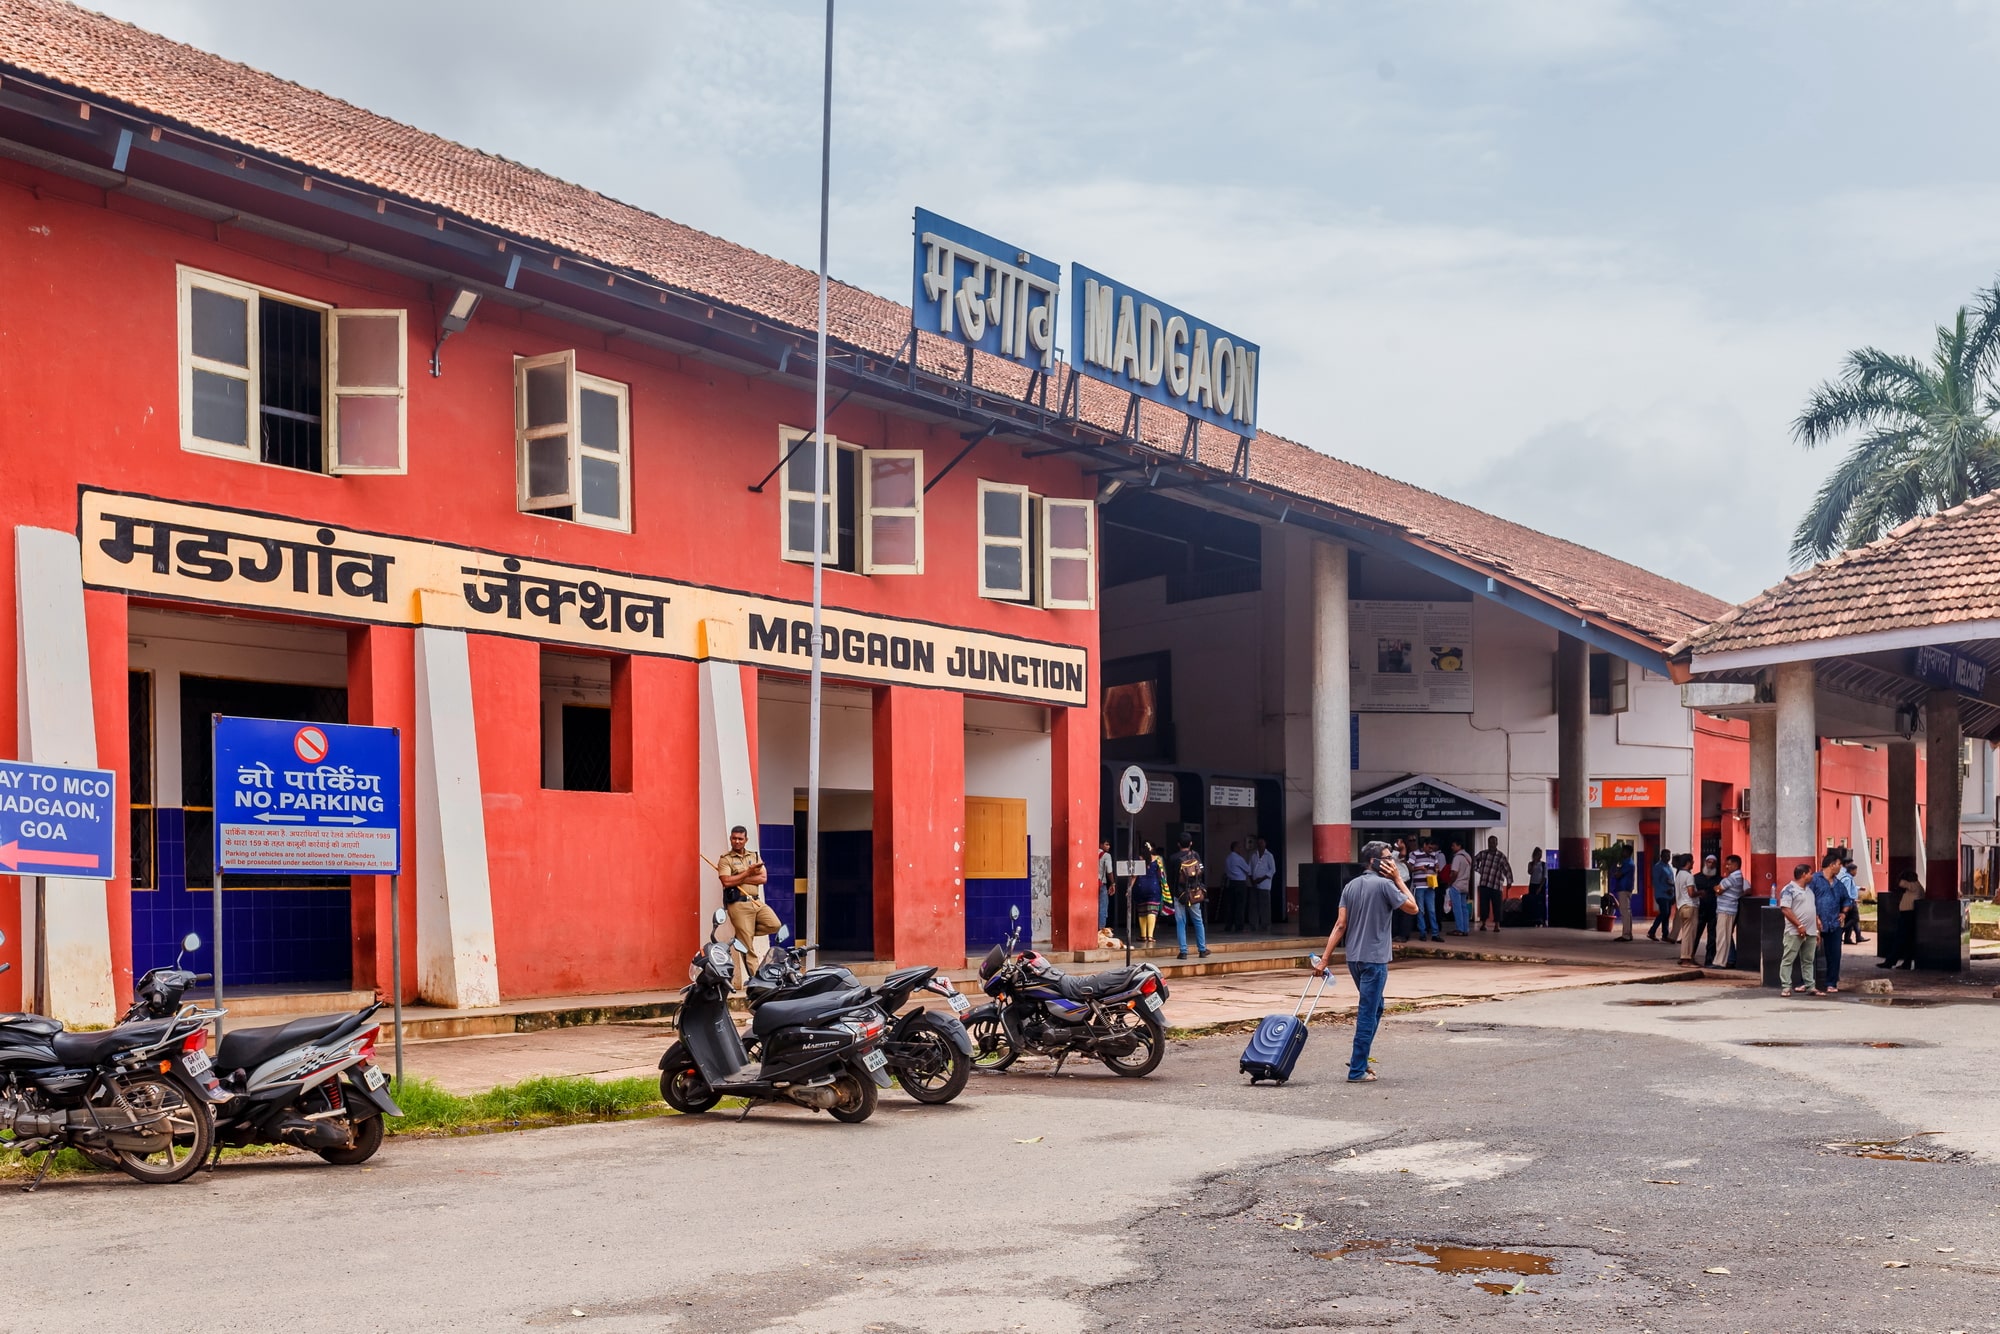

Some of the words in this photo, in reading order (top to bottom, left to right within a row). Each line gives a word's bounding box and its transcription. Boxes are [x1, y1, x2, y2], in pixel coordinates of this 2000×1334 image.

[1084, 278, 1256, 424] MADGAON
[99, 512, 396, 603] मडगांव
[461, 557, 670, 639] जंक्शन
[749, 613, 934, 673] MADGAON
[947, 646, 1082, 692] JUNCTION
[29, 773, 58, 792] TO
[63, 777, 110, 798] MCO
[284, 765, 381, 793] पार्किंग
[0, 794, 100, 823] ADGAON,
[235, 790, 272, 808] NO
[279, 792, 384, 812] PARKING
[20, 820, 68, 841] GOA
[225, 850, 249, 858] Parking
[258, 850, 284, 858] vehicles
[802, 1040, 841, 1050] MAESTRO
[187, 1055, 196, 1065] GA
